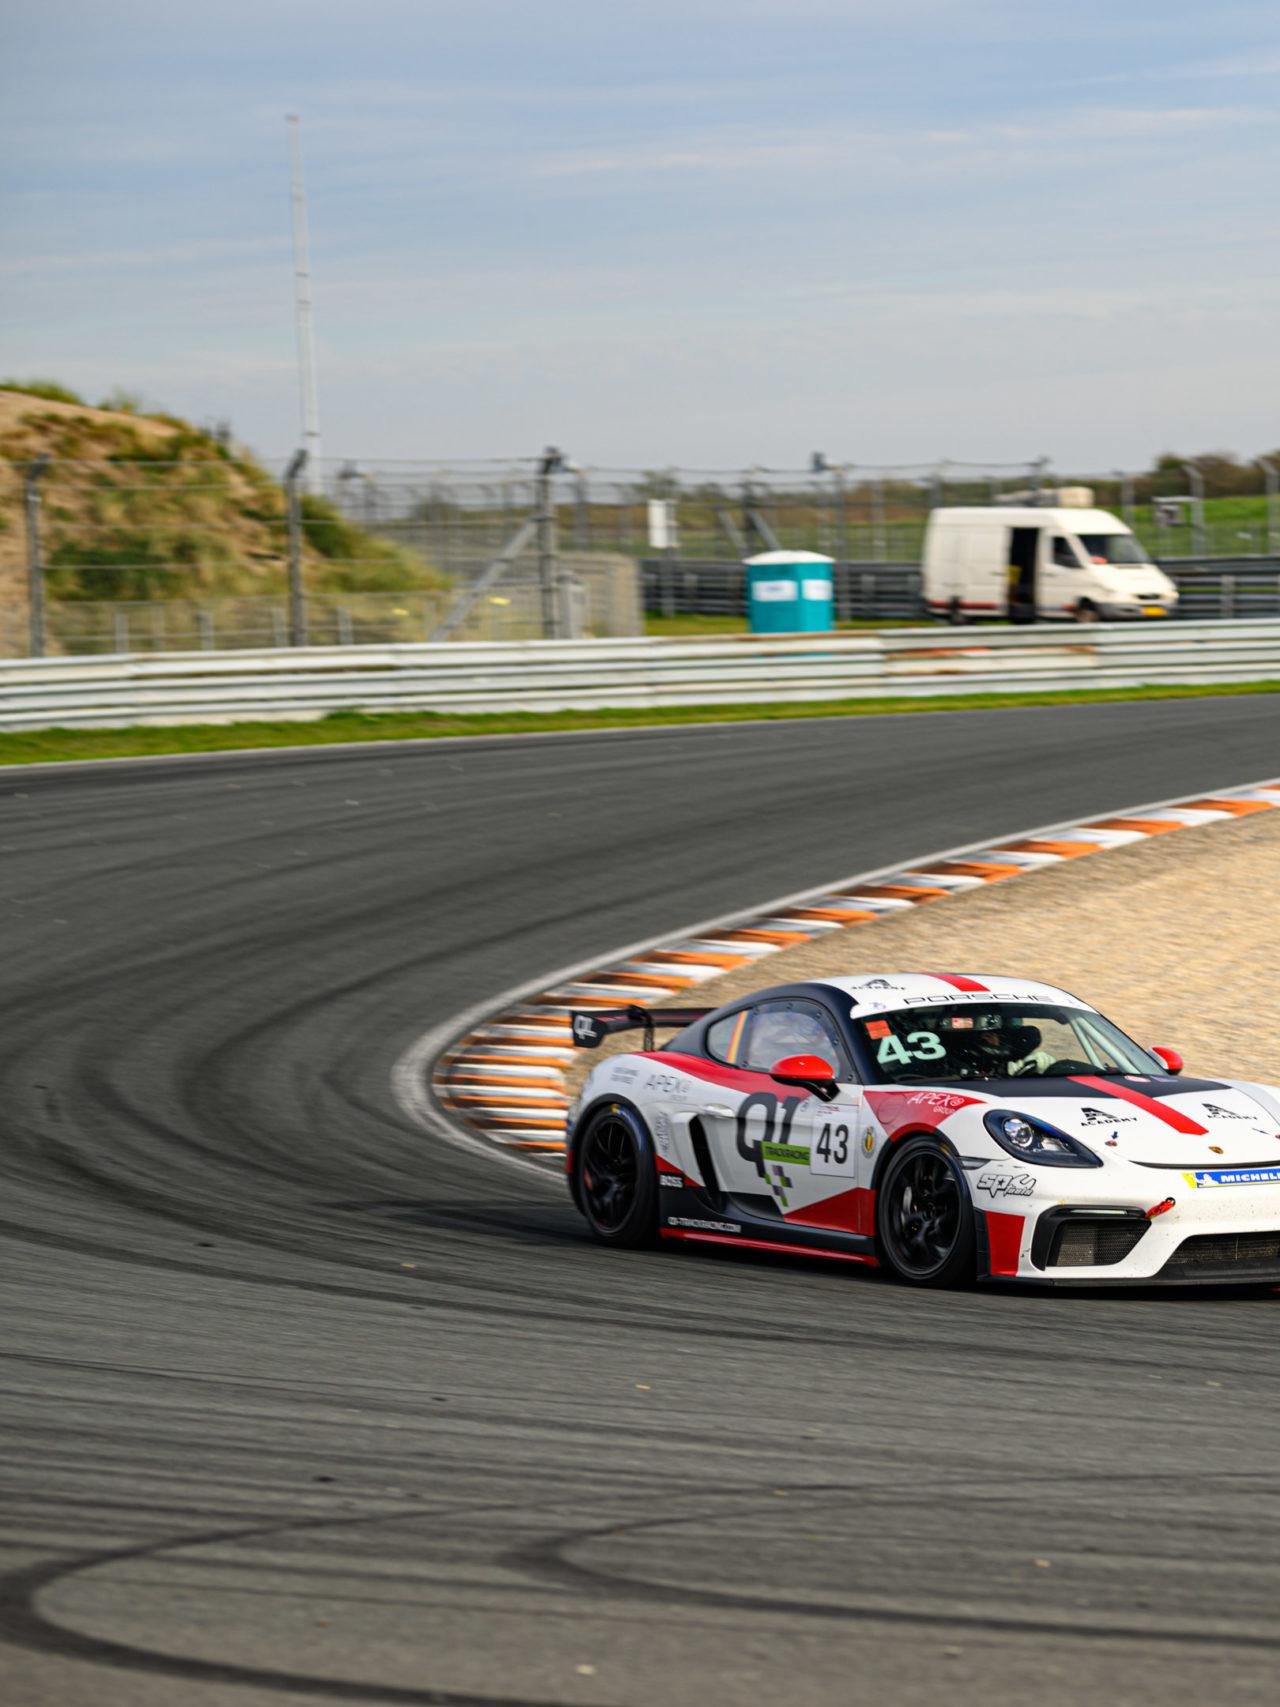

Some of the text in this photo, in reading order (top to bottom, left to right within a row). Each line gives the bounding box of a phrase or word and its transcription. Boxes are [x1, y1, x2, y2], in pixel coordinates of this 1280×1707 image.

[903, 993, 1054, 1005] PORSCHE
[877, 1031, 947, 1065] 43
[907, 1092, 952, 1107] APEX
[816, 1122, 849, 1164] 43
